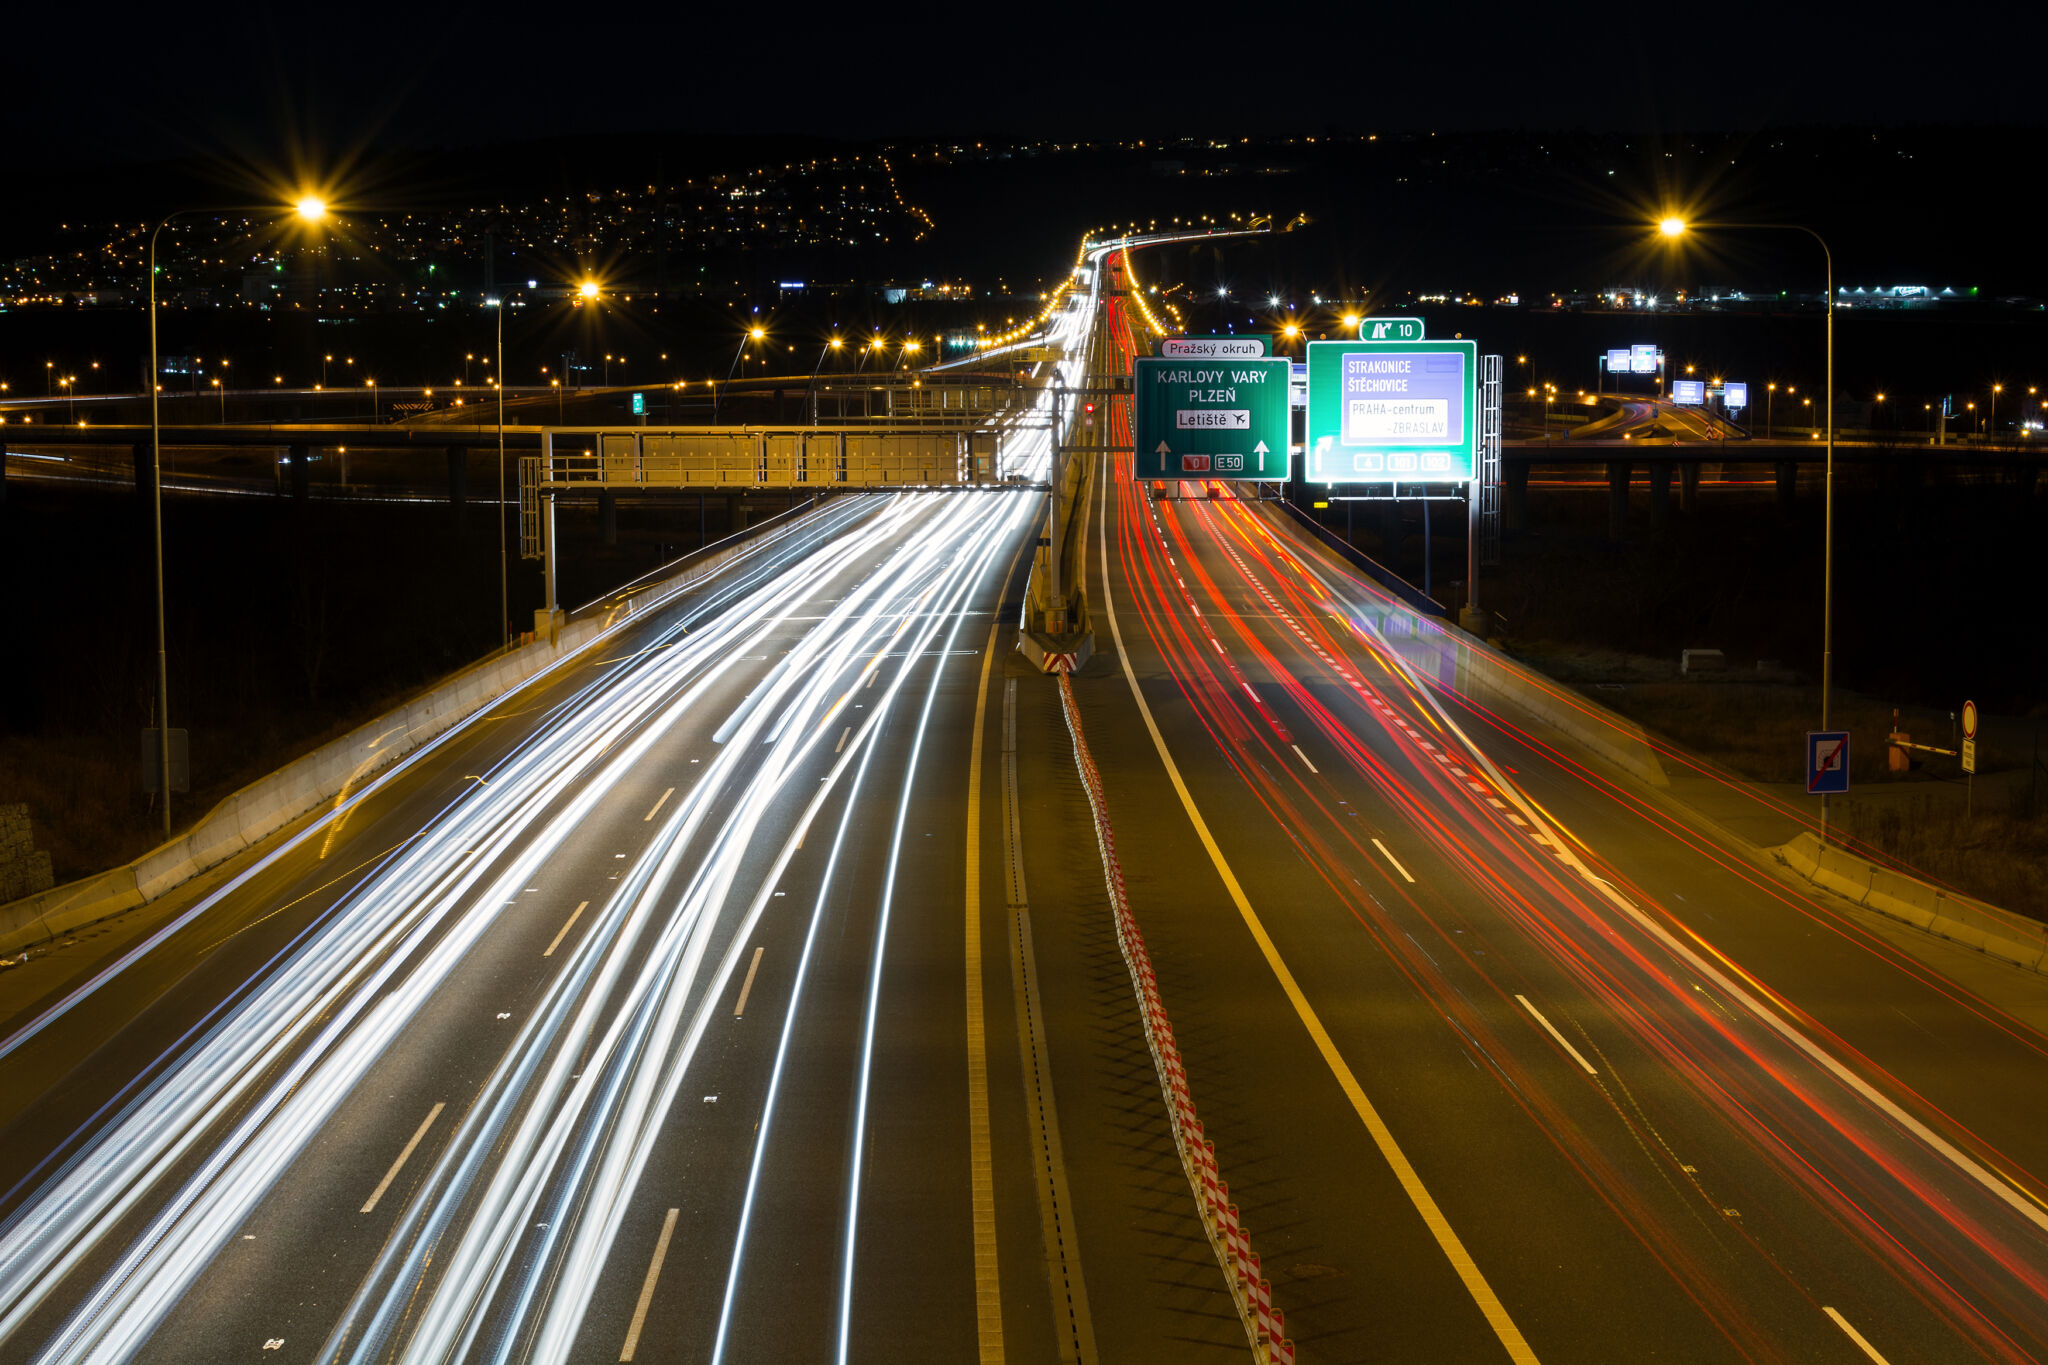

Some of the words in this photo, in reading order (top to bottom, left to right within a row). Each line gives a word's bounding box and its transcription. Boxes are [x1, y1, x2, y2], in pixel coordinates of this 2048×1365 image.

[1399, 324, 1413, 337] 10
[1170, 342, 1216, 356] Pražský
[1222, 343, 1256, 354] okruh
[1348, 360, 1411, 374] STRAKONICE
[1157, 371, 1224, 383] KARLOVY
[1231, 371, 1267, 383] VARY
[1348, 377, 1408, 392] ŠTĚCHOVICE
[1189, 387, 1236, 402] PLZEŇ
[1353, 403, 1435, 415] PRAHA-centrum
[1179, 413, 1227, 426] Letiště
